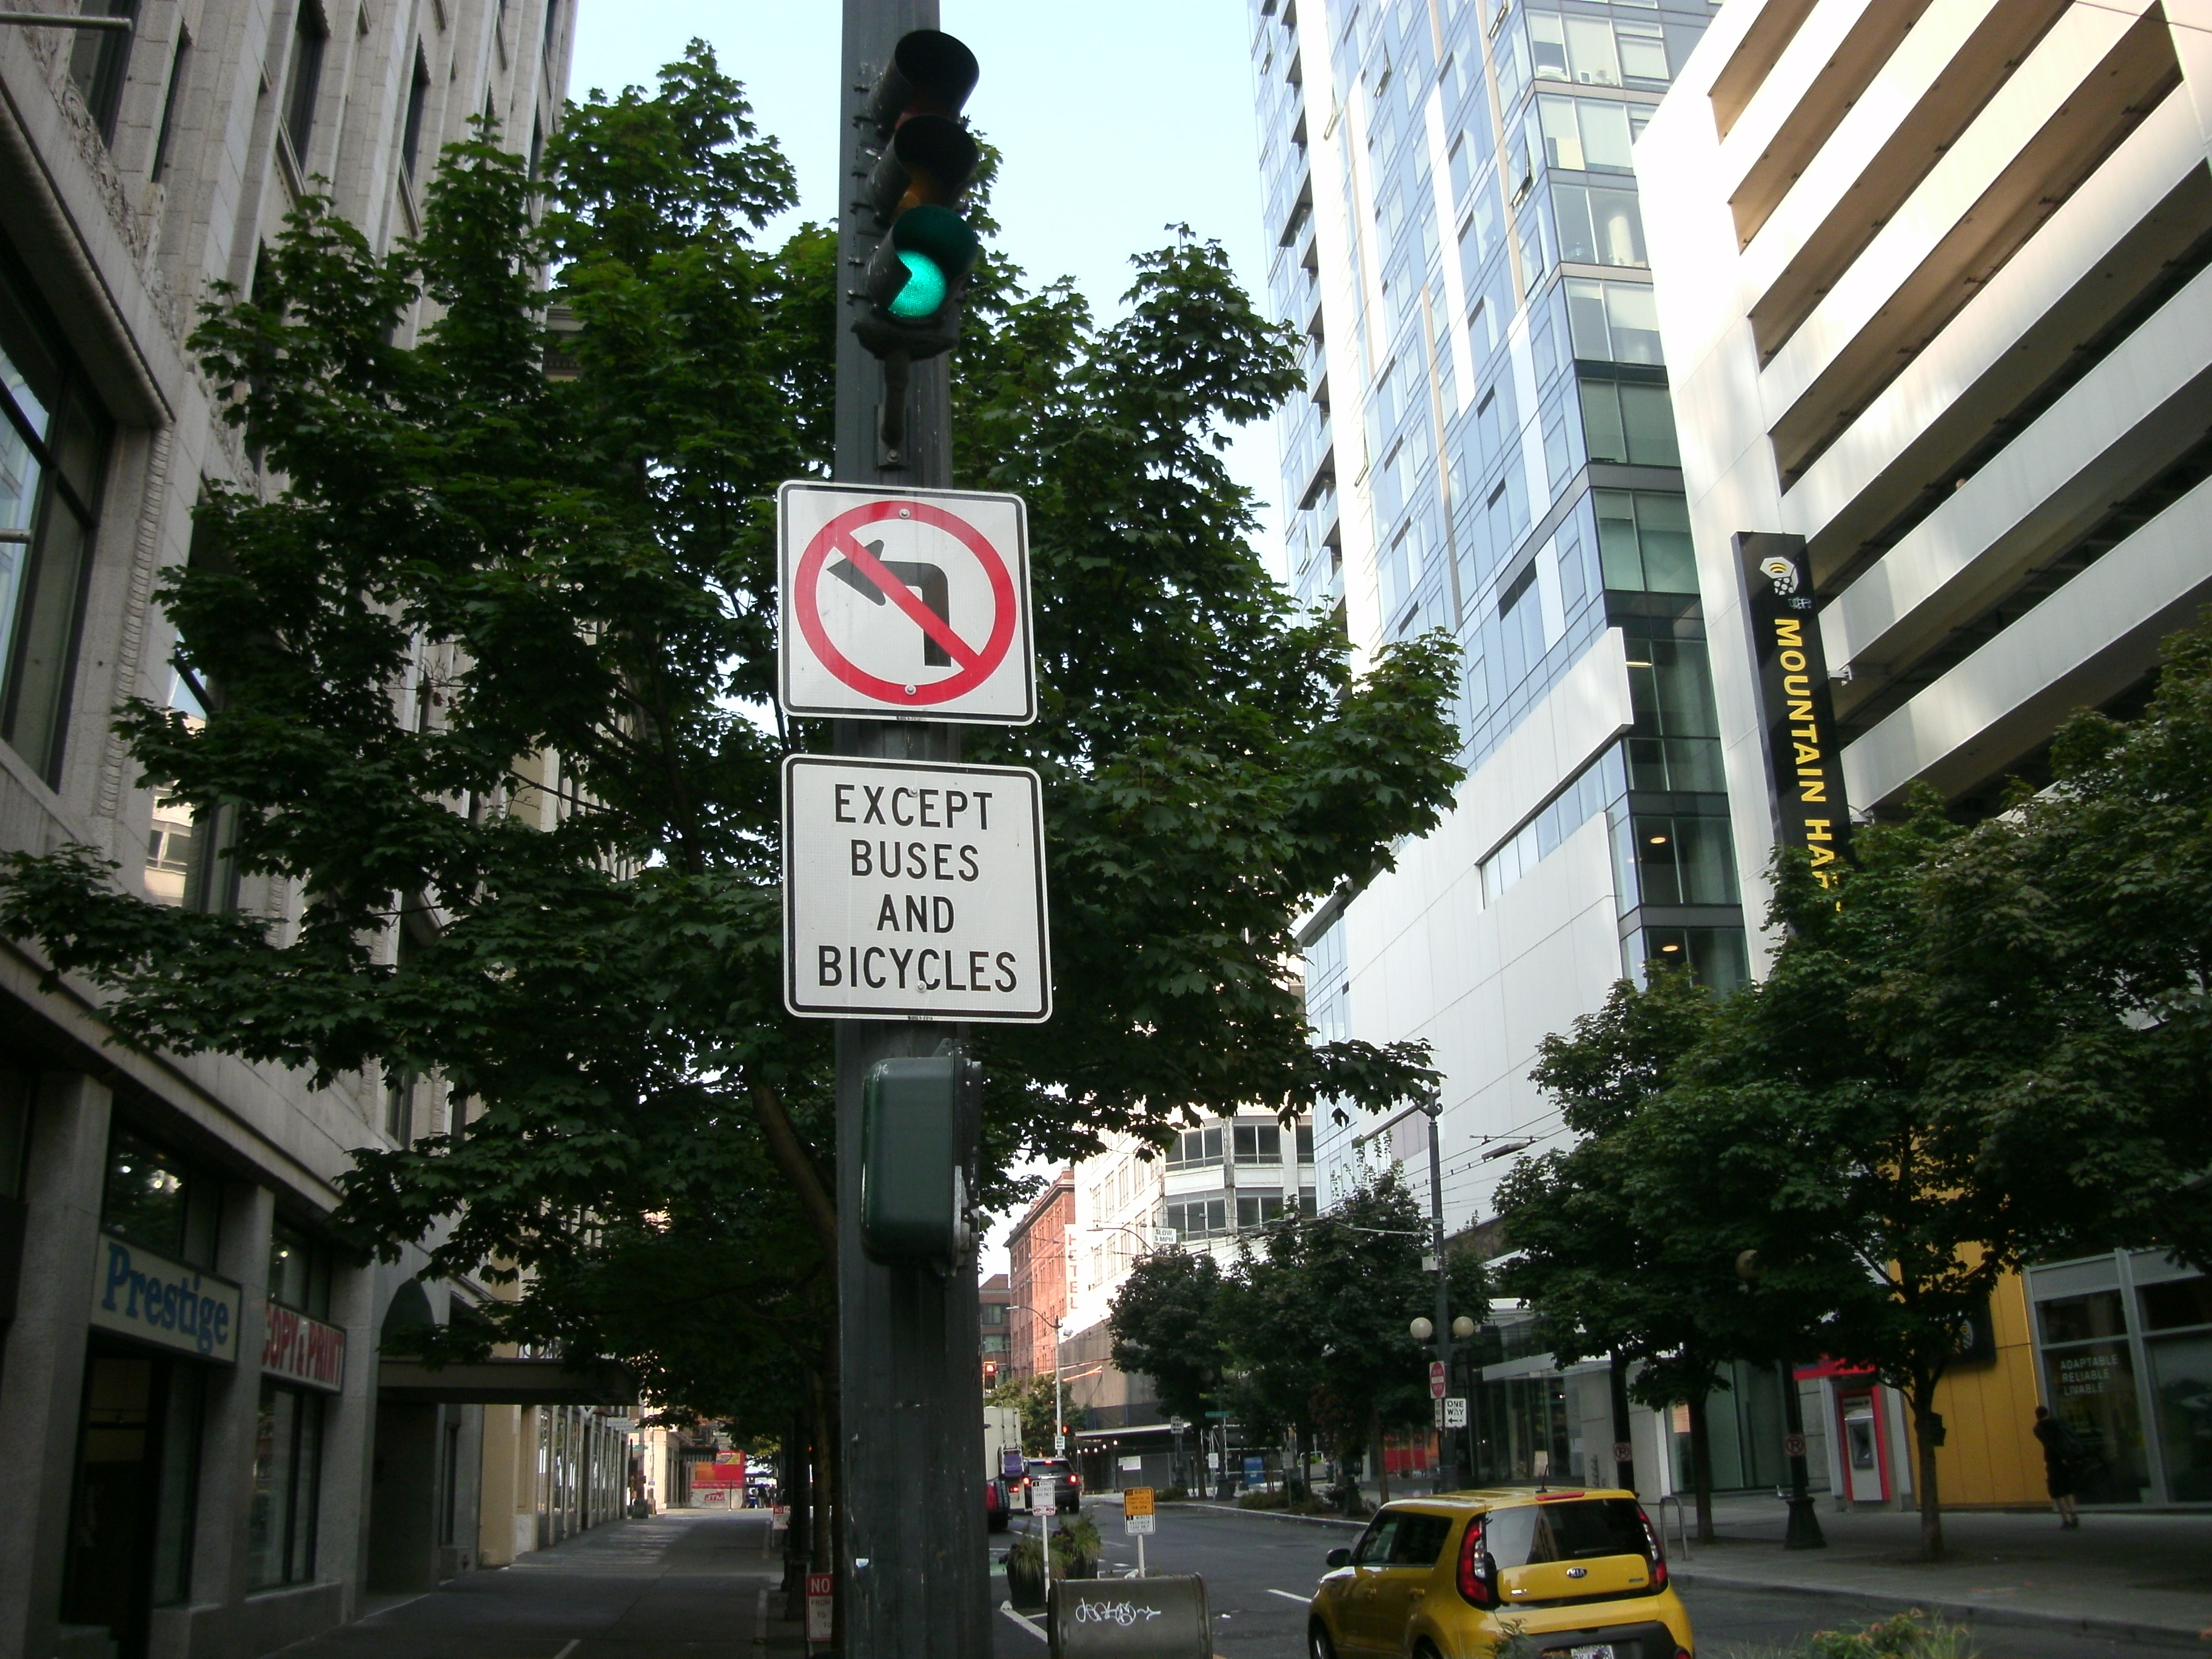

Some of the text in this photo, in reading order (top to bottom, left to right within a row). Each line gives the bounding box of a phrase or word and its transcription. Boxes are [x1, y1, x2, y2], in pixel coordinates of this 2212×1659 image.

[1774, 618, 1827, 802] MOUNTAIN
[834, 783, 993, 831] EXCEPT
[851, 839, 980, 882] BUSES
[877, 894, 955, 933] AND
[819, 945, 1017, 993] BICYCLES
[102, 1242, 229, 1356] Prestige
[306, 1321, 344, 1386] PRINT
[2060, 1354, 2119, 1370] ADAPTABLE
[2062, 1368, 2110, 1382] RELIABLE
[2063, 1382, 2104, 1396] LIVABLE
[811, 1577, 830, 1594] NO
[1567, 1568, 1586, 1578] KIA
